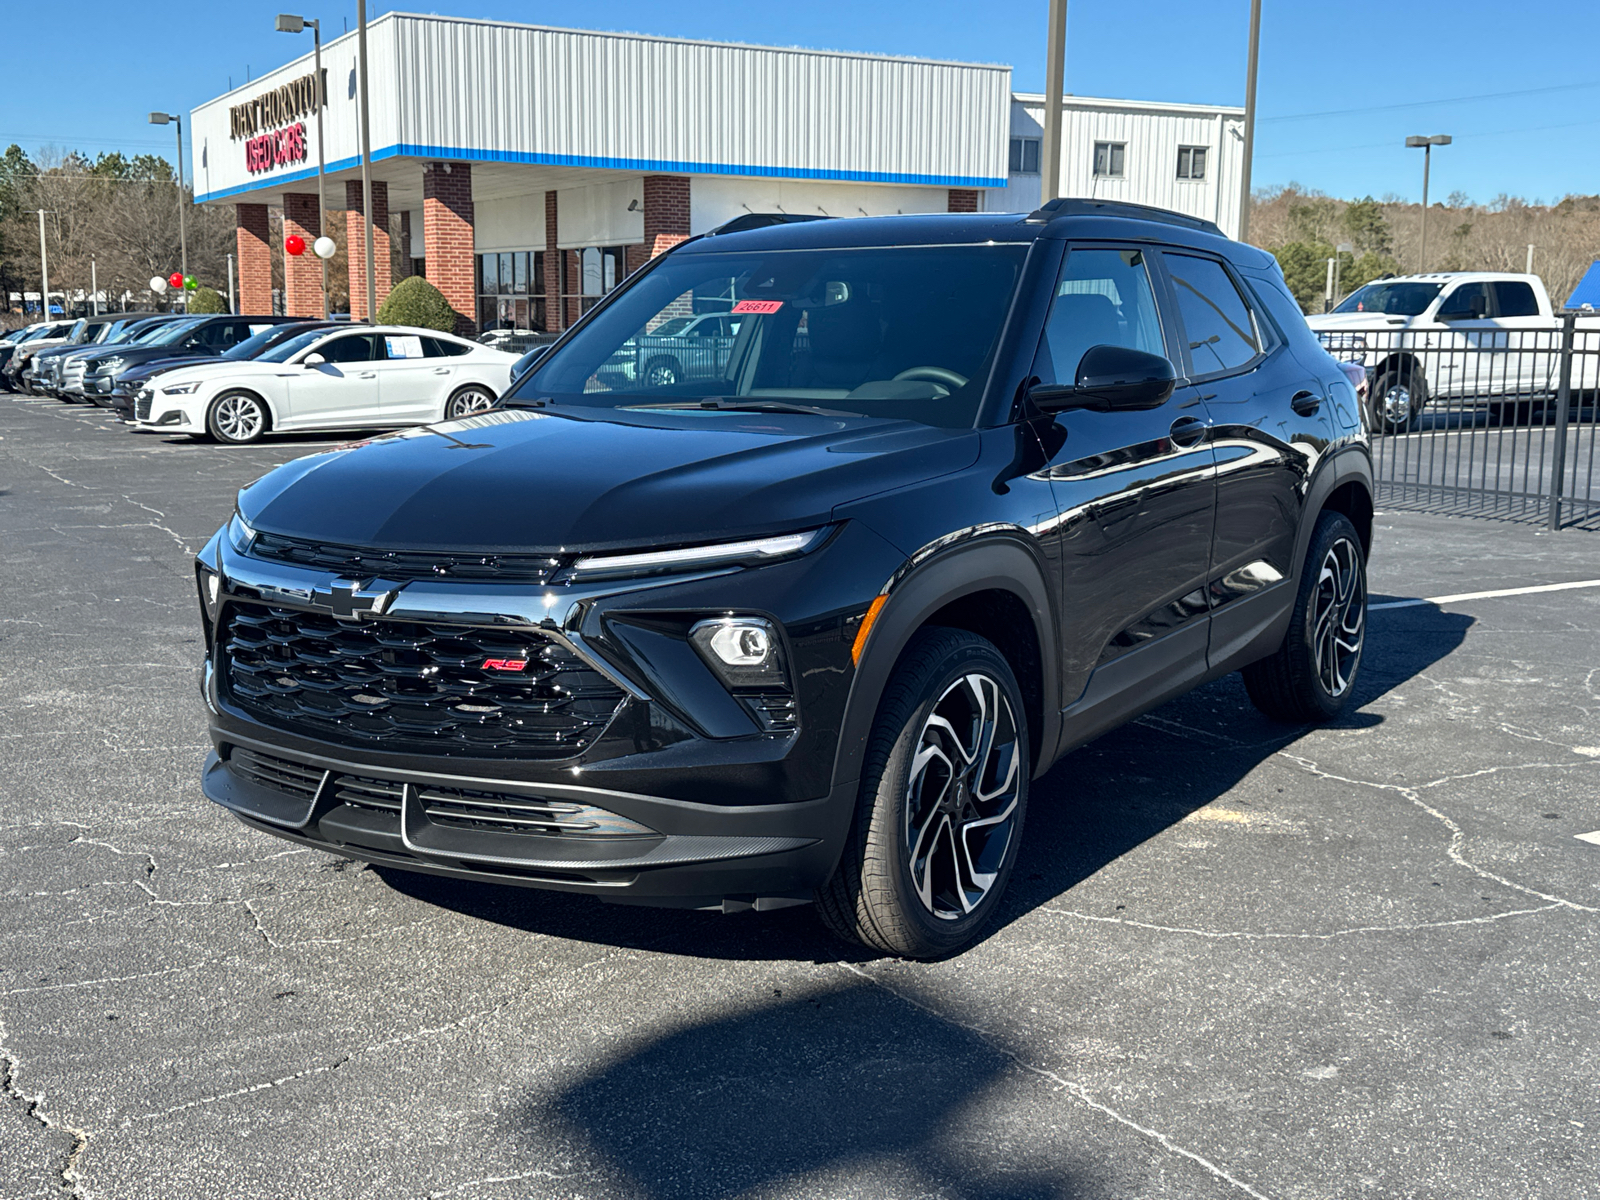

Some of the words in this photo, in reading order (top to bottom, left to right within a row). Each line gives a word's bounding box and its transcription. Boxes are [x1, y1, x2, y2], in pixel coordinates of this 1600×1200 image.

[229, 100, 258, 139] JOHN
[245, 134, 272, 172] USED
[273, 122, 307, 165] CARS
[739, 302, 775, 311] 26611
[481, 658, 527, 671] RS
